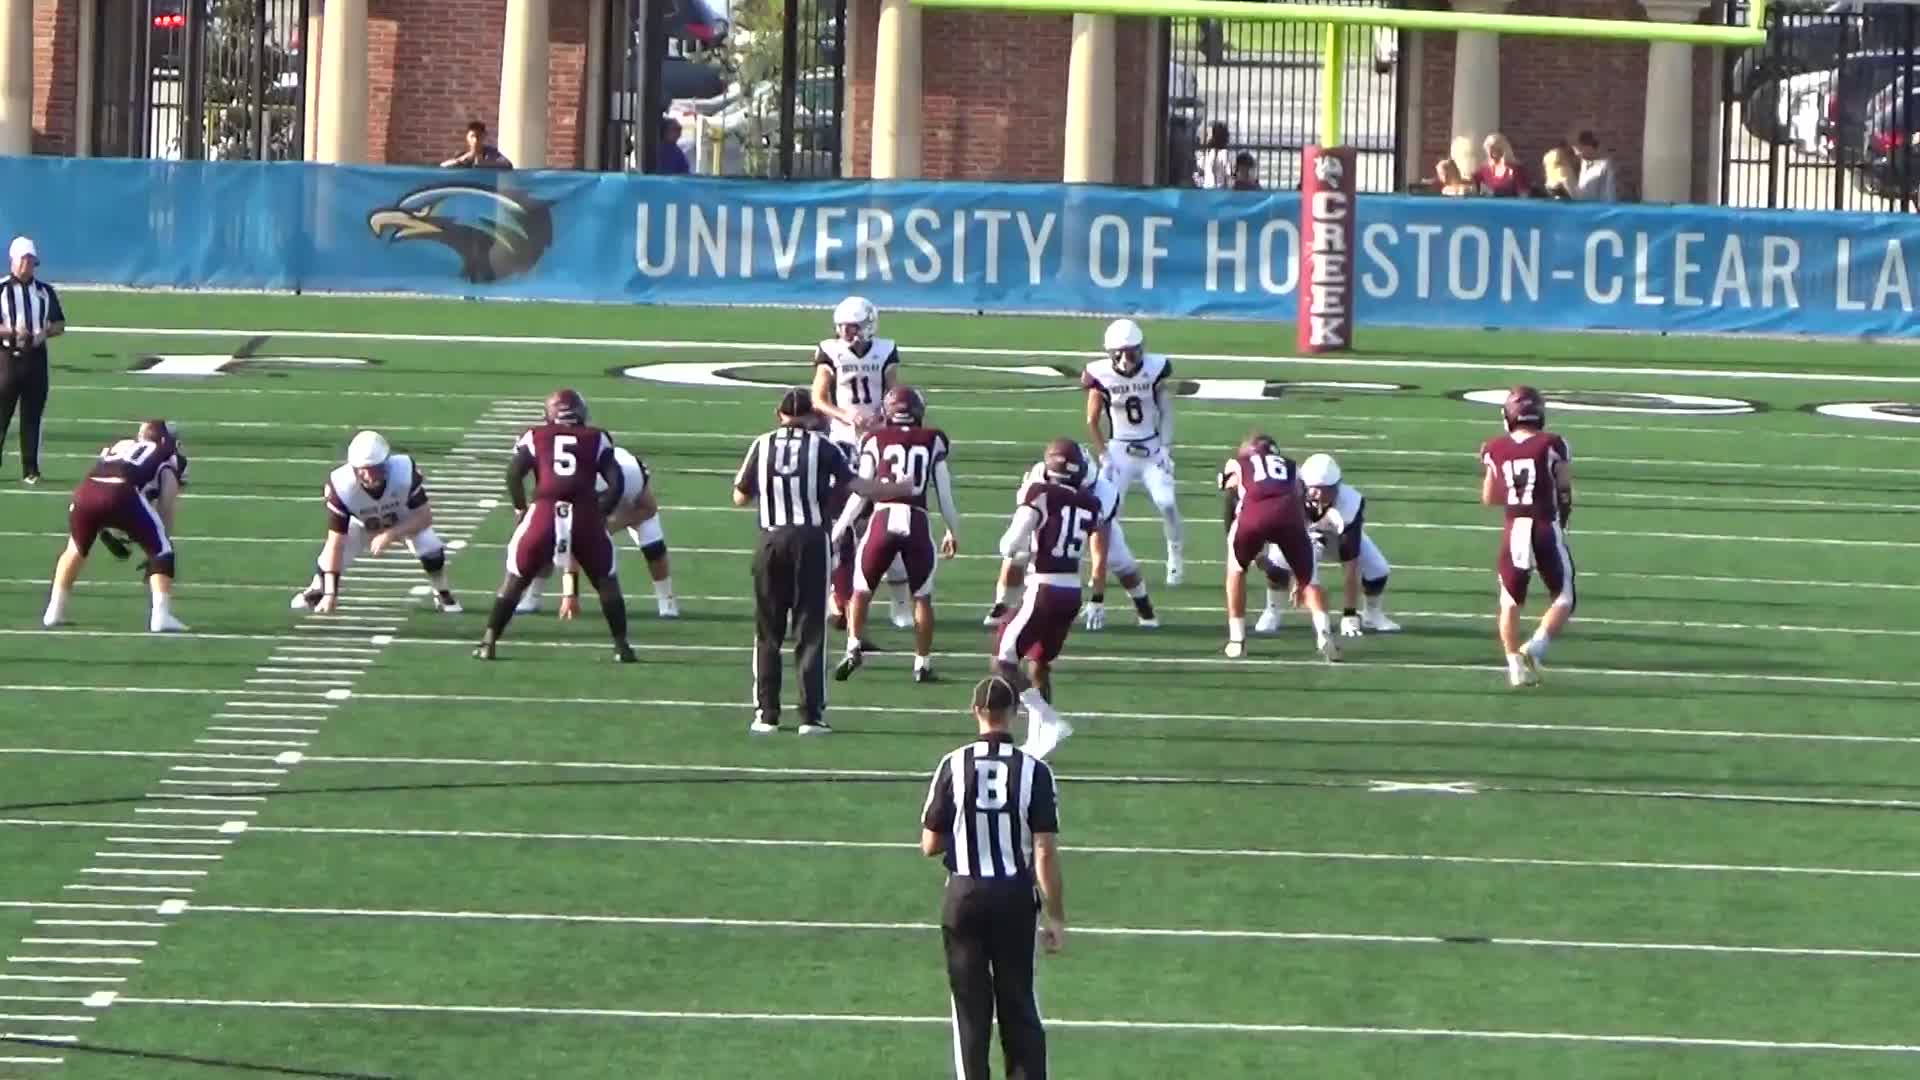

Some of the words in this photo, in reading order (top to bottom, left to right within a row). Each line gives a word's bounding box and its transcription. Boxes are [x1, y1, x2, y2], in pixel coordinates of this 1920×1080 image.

[636, 202, 1057, 288] UNIVERSITY
[1089, 213, 1174, 290] OF
[1205, 219, 1801, 309] HOSTON-CLEAR
[1836, 237, 1914, 313] LA
[1309, 191, 1348, 346] CREEK
[850, 376, 872, 404] 11
[553, 434, 578, 476] 5
[774, 438, 802, 474] U
[882, 443, 930, 496] 30
[1249, 454, 1288, 482] 16
[1501, 458, 1536, 505] 17
[1051, 505, 1093, 559] 15
[975, 759, 1009, 810] B
